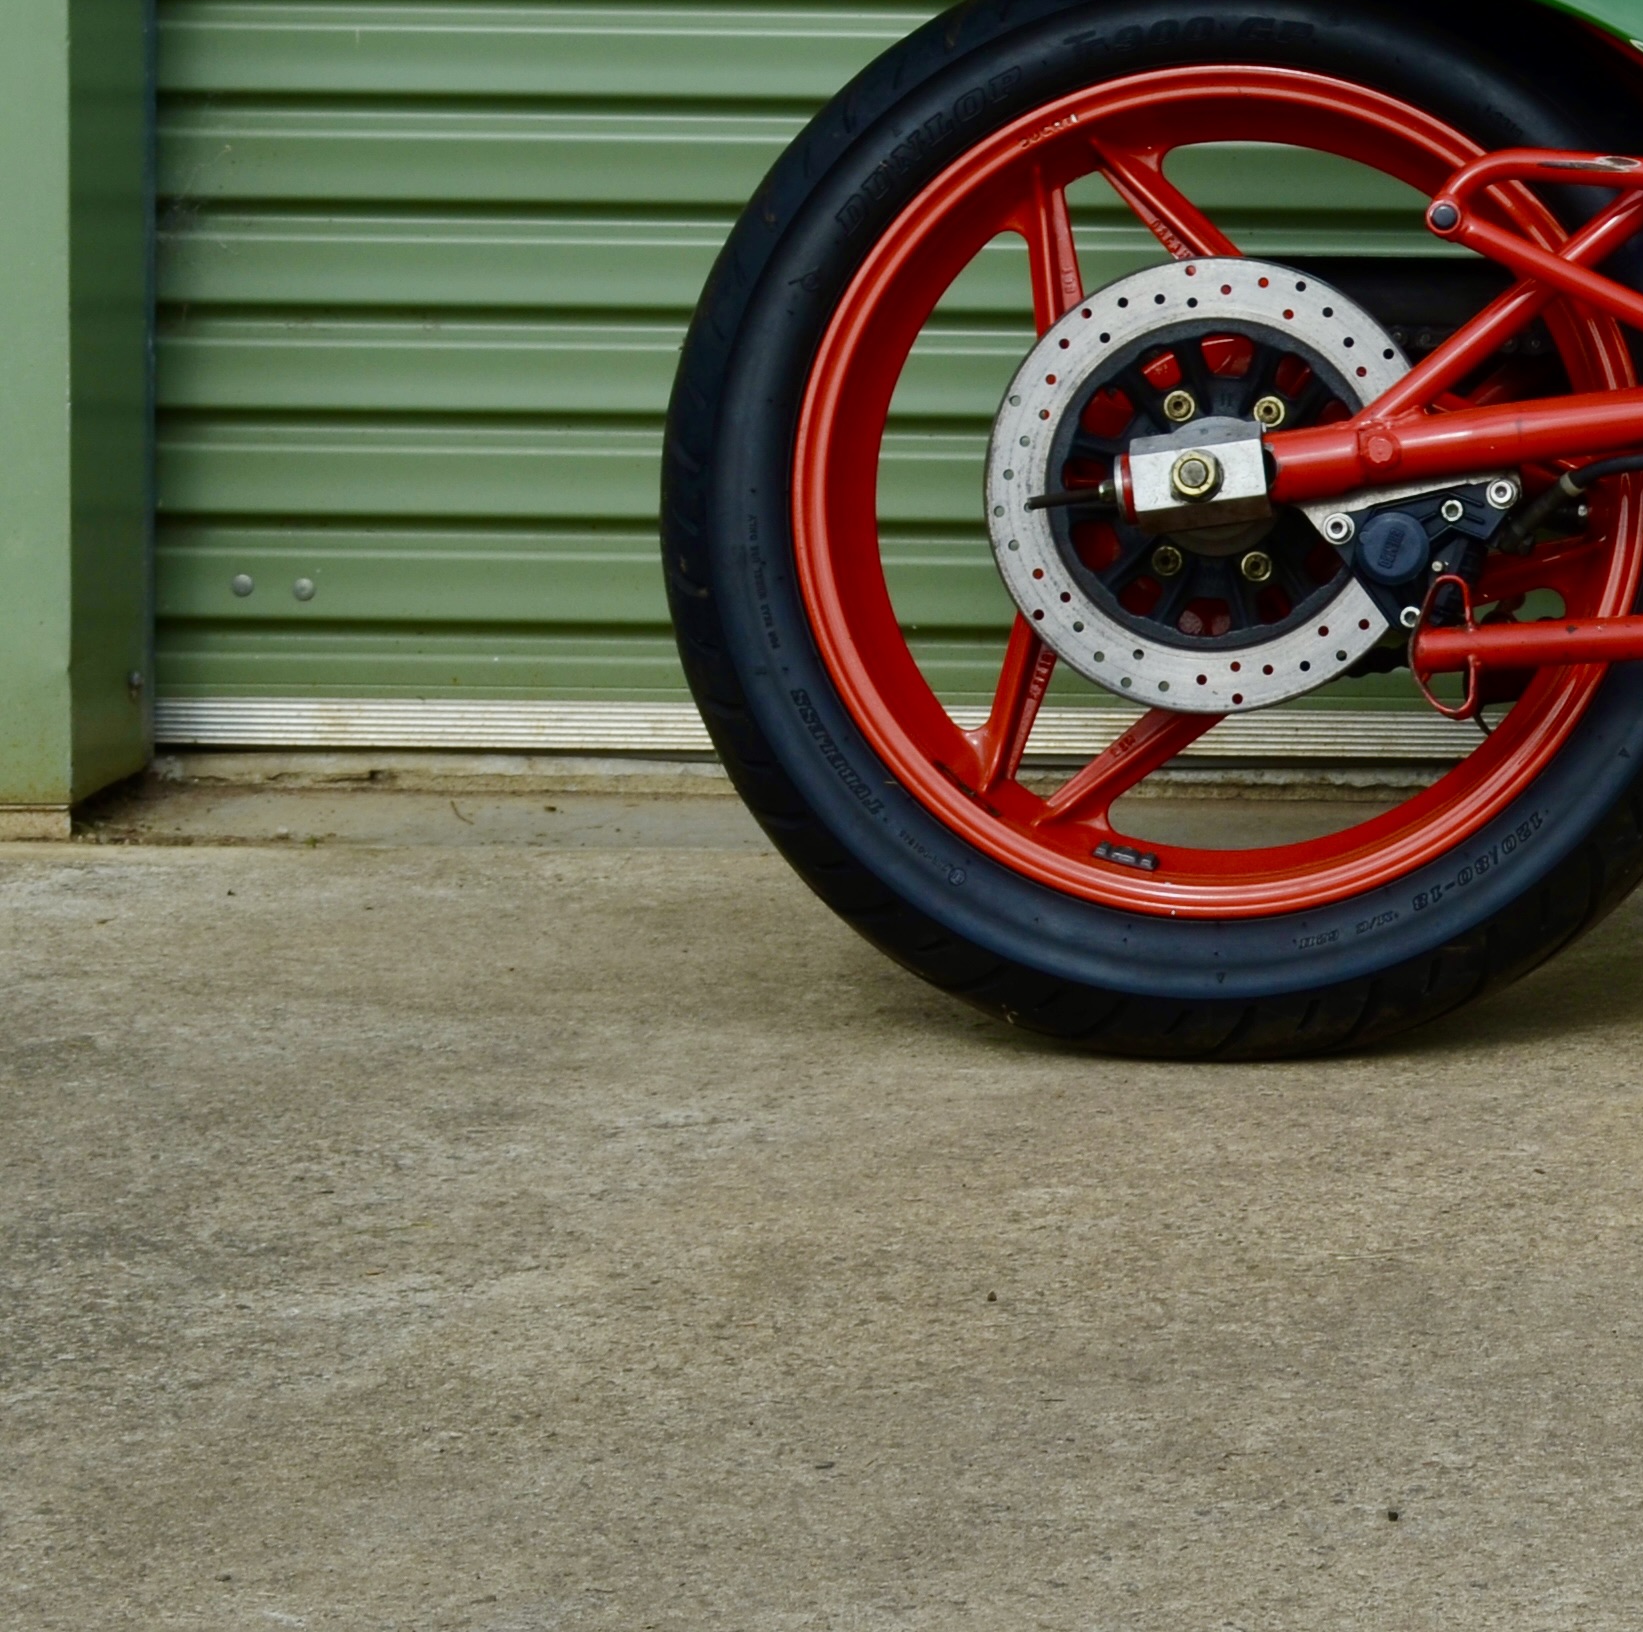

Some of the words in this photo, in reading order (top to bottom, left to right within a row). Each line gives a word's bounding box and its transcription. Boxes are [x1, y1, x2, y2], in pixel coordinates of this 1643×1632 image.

[834, 64, 1027, 236] DUNLOP
[745, 513, 758, 541] ONLY
[790, 687, 886, 816] TUBELESS
